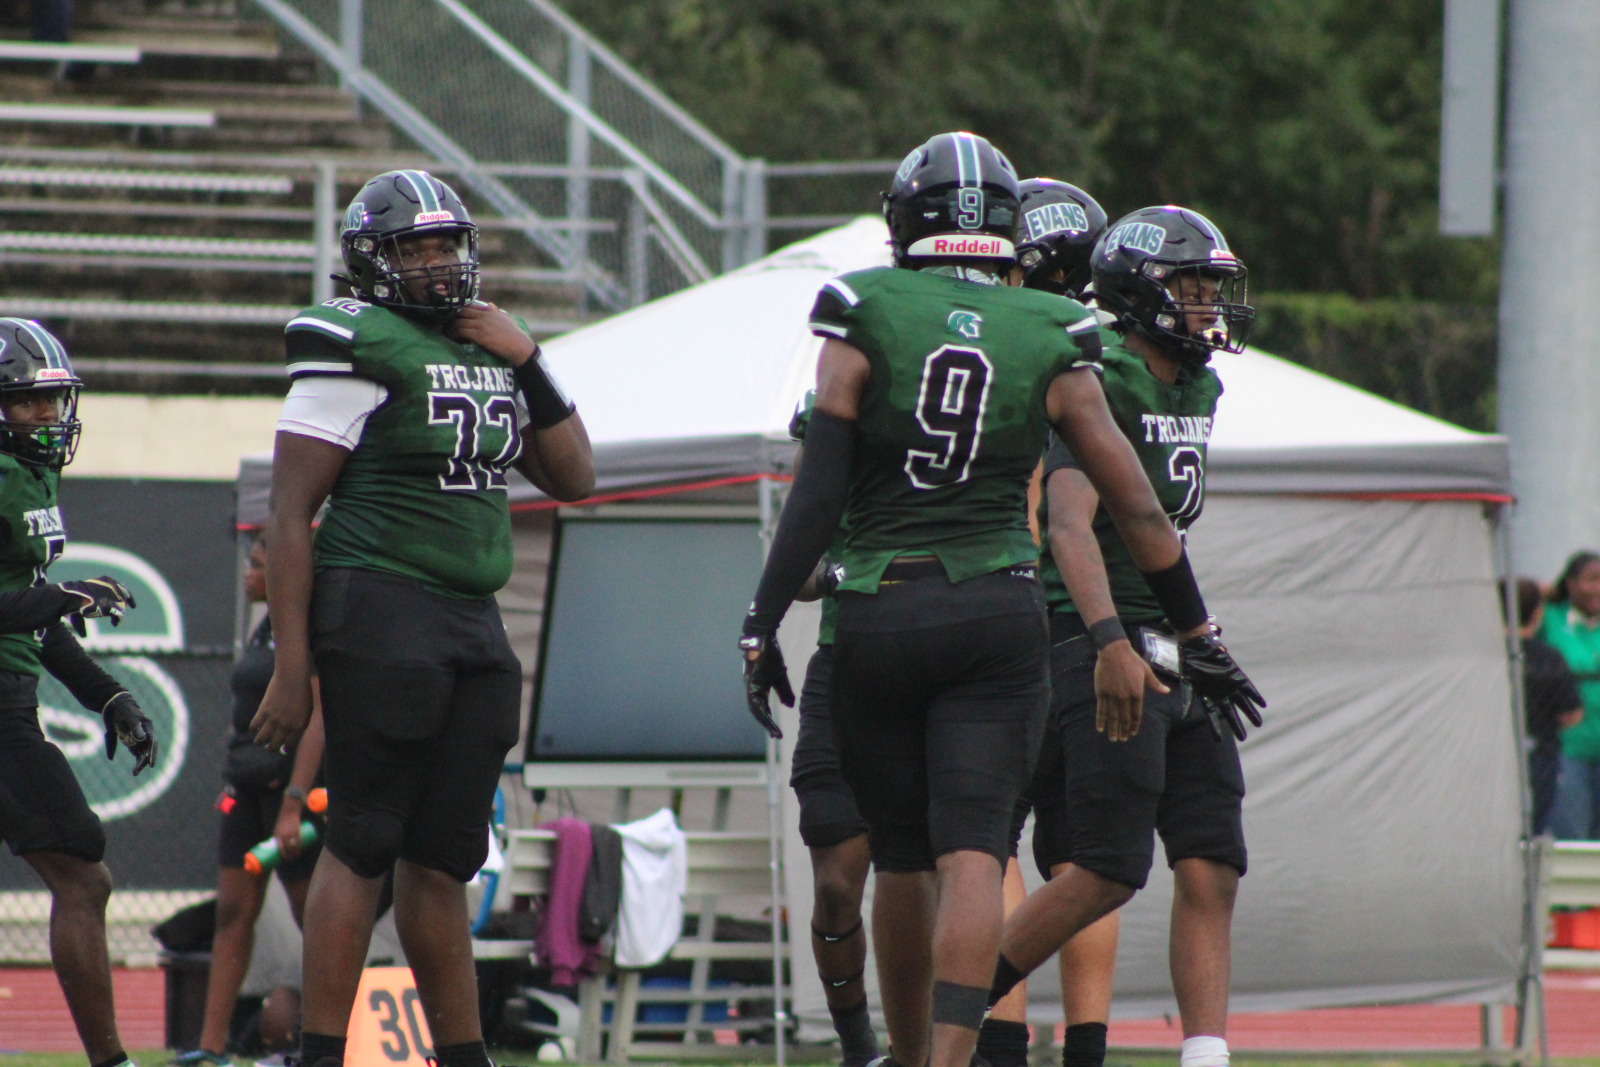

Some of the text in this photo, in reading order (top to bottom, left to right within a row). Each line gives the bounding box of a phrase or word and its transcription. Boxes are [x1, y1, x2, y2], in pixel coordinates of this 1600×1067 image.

[419, 212, 450, 222] Riddell
[958, 187, 983, 229] 9
[1025, 203, 1089, 241] EVANS
[934, 239, 1001, 254] Riddell
[1104, 222, 1167, 256] EVANS
[41, 371, 67, 379] Riddell
[425, 364, 514, 392] TROJANS
[904, 343, 994, 490] 9
[1141, 413, 1212, 443] TROJANS
[426, 391, 523, 491] 72
[368, 987, 437, 1062] 30
